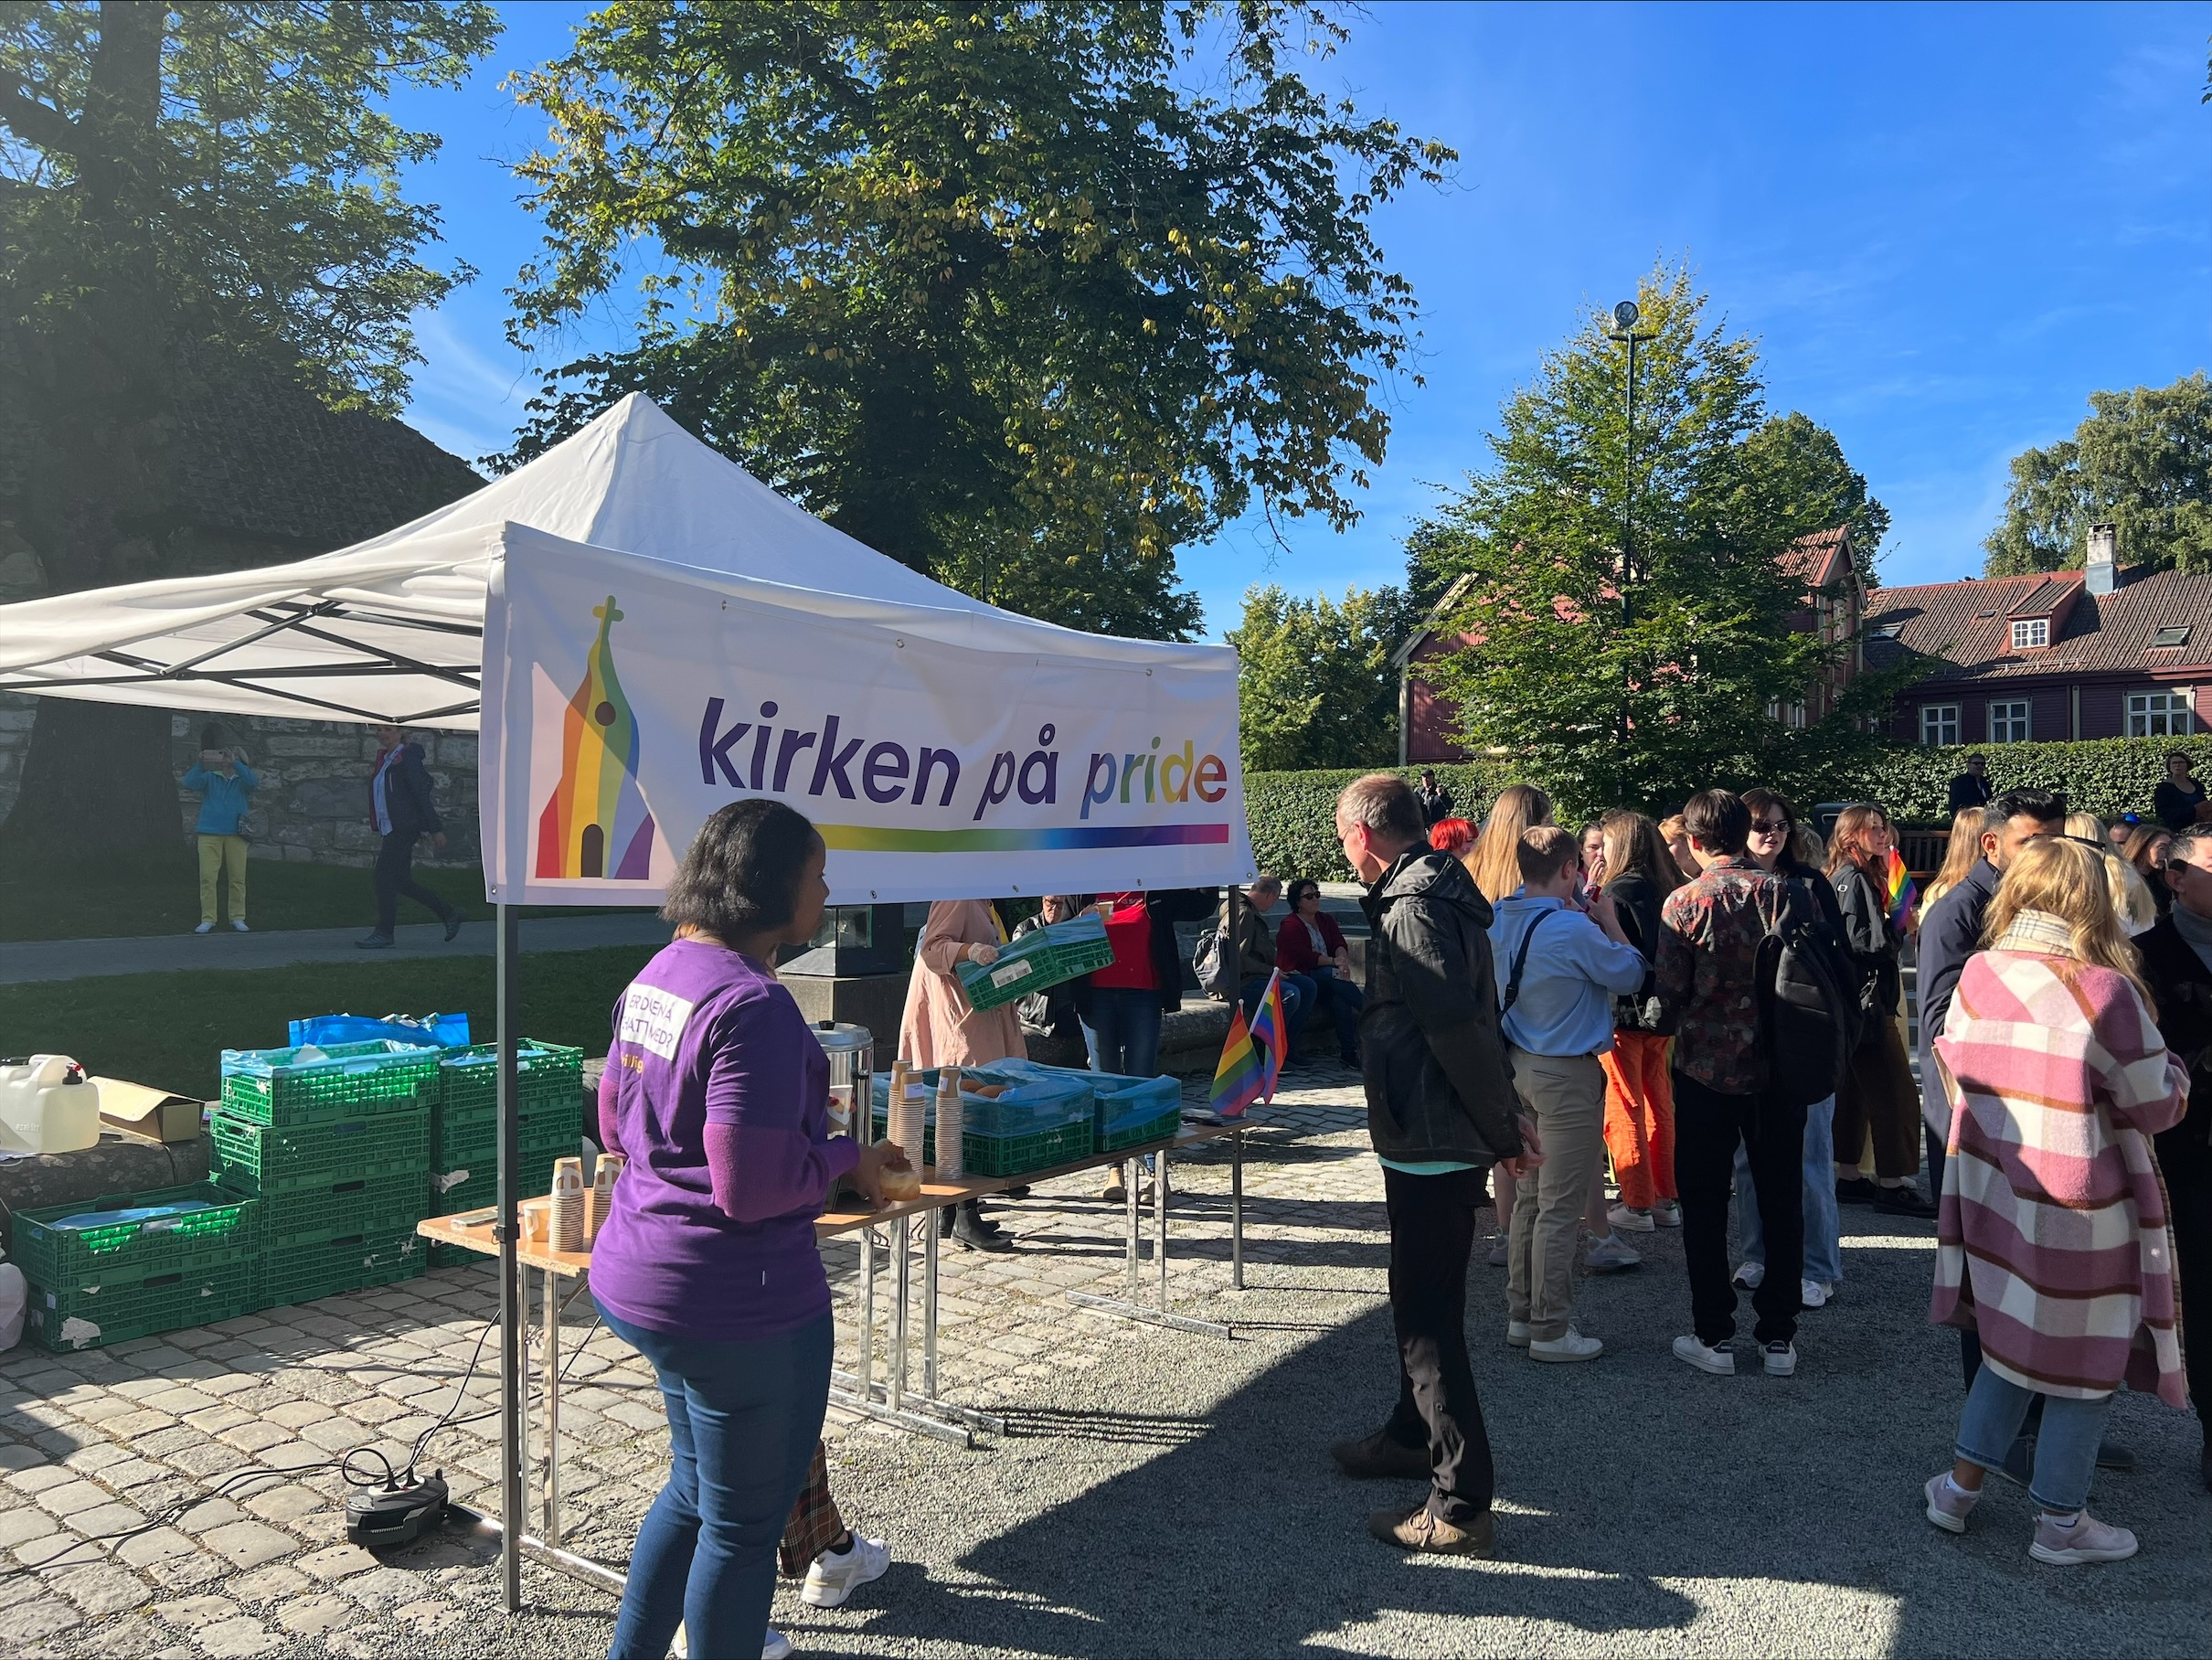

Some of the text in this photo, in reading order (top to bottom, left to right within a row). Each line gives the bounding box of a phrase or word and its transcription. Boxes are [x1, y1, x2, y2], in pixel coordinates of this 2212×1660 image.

[698, 697, 1228, 821] kirken på pride
